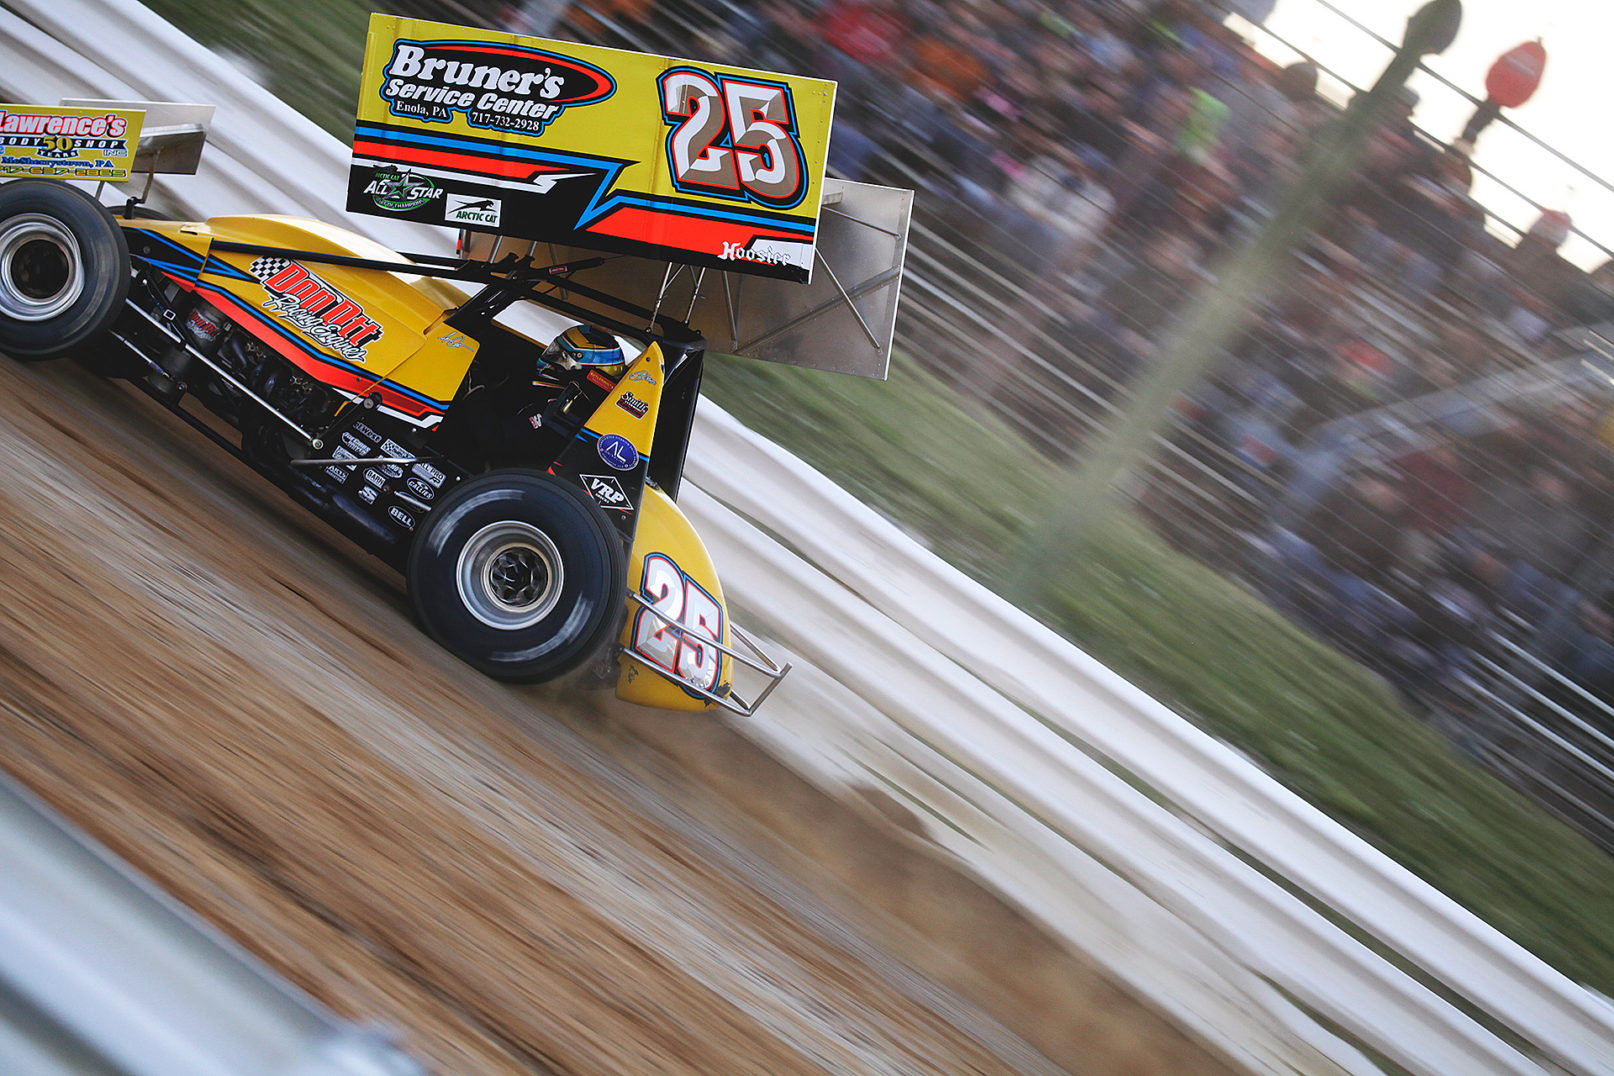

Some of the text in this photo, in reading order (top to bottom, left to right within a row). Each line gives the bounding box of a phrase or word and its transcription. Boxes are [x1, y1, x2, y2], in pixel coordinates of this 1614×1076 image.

[389, 45, 564, 98] Bruner's
[386, 79, 559, 120] Service Center
[396, 100, 448, 118] Enola, PA
[472, 111, 541, 132] 717-732-2928
[42, 135, 73, 152] 50
[73, 139, 119, 149] SHOP
[661, 70, 804, 202] 25
[1, 156, 114, 168] McSherrystown, PA
[40, 150, 77, 159] YEARS
[406, 186, 444, 200] STAR
[456, 210, 498, 224] ARCTIC CAT
[717, 241, 791, 267] Hoosier
[265, 261, 337, 317] Don
[319, 299, 381, 347] Ott
[262, 293, 368, 362] Racing Engines
[408, 480, 433, 499] CALLIES
[590, 478, 625, 504] VRP
[390, 507, 412, 526] BELL
[633, 553, 720, 698] 25
